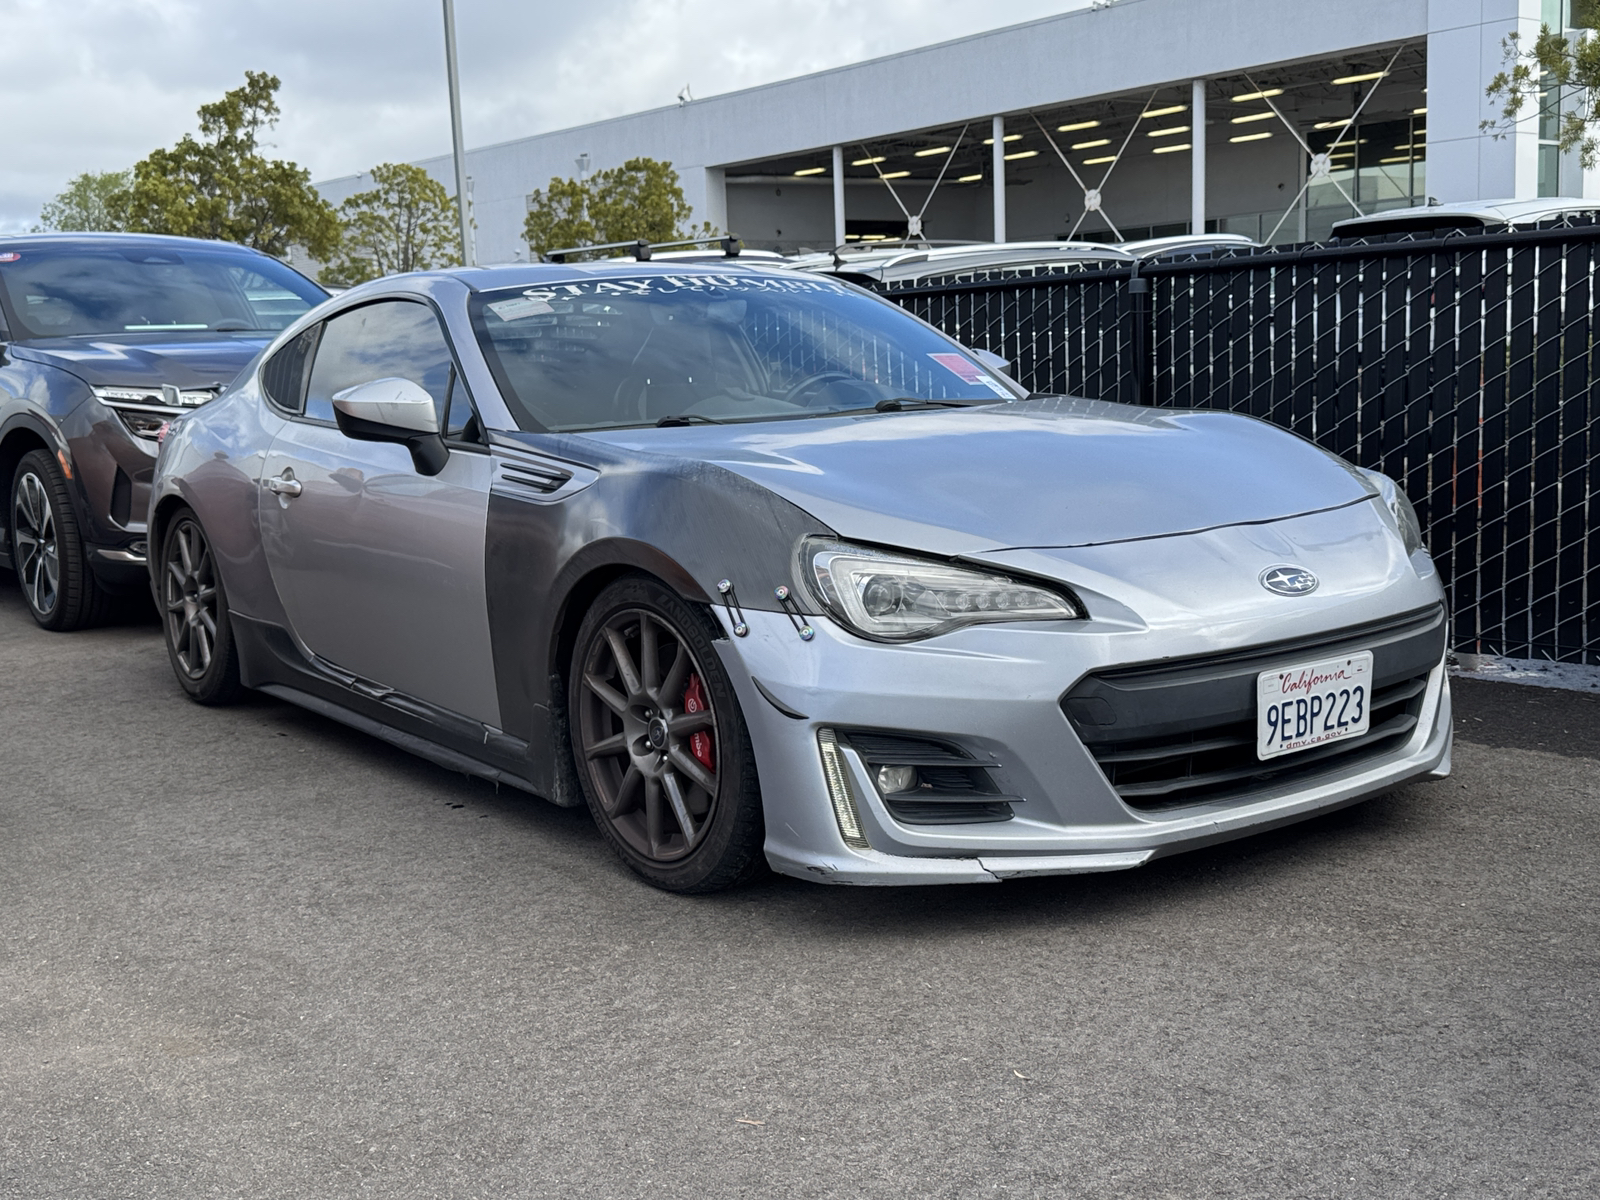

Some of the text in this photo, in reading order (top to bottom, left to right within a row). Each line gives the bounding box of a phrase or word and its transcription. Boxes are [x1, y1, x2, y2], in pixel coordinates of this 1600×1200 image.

[522, 279, 654, 298] STAY
[656, 594, 727, 699] LANDGOLDEN
[1281, 668, 1352, 694] California
[1267, 685, 1365, 746] 9EBP223
[694, 732, 703, 758] mbo
[1286, 730, 1343, 750] dmv.ca.gov
